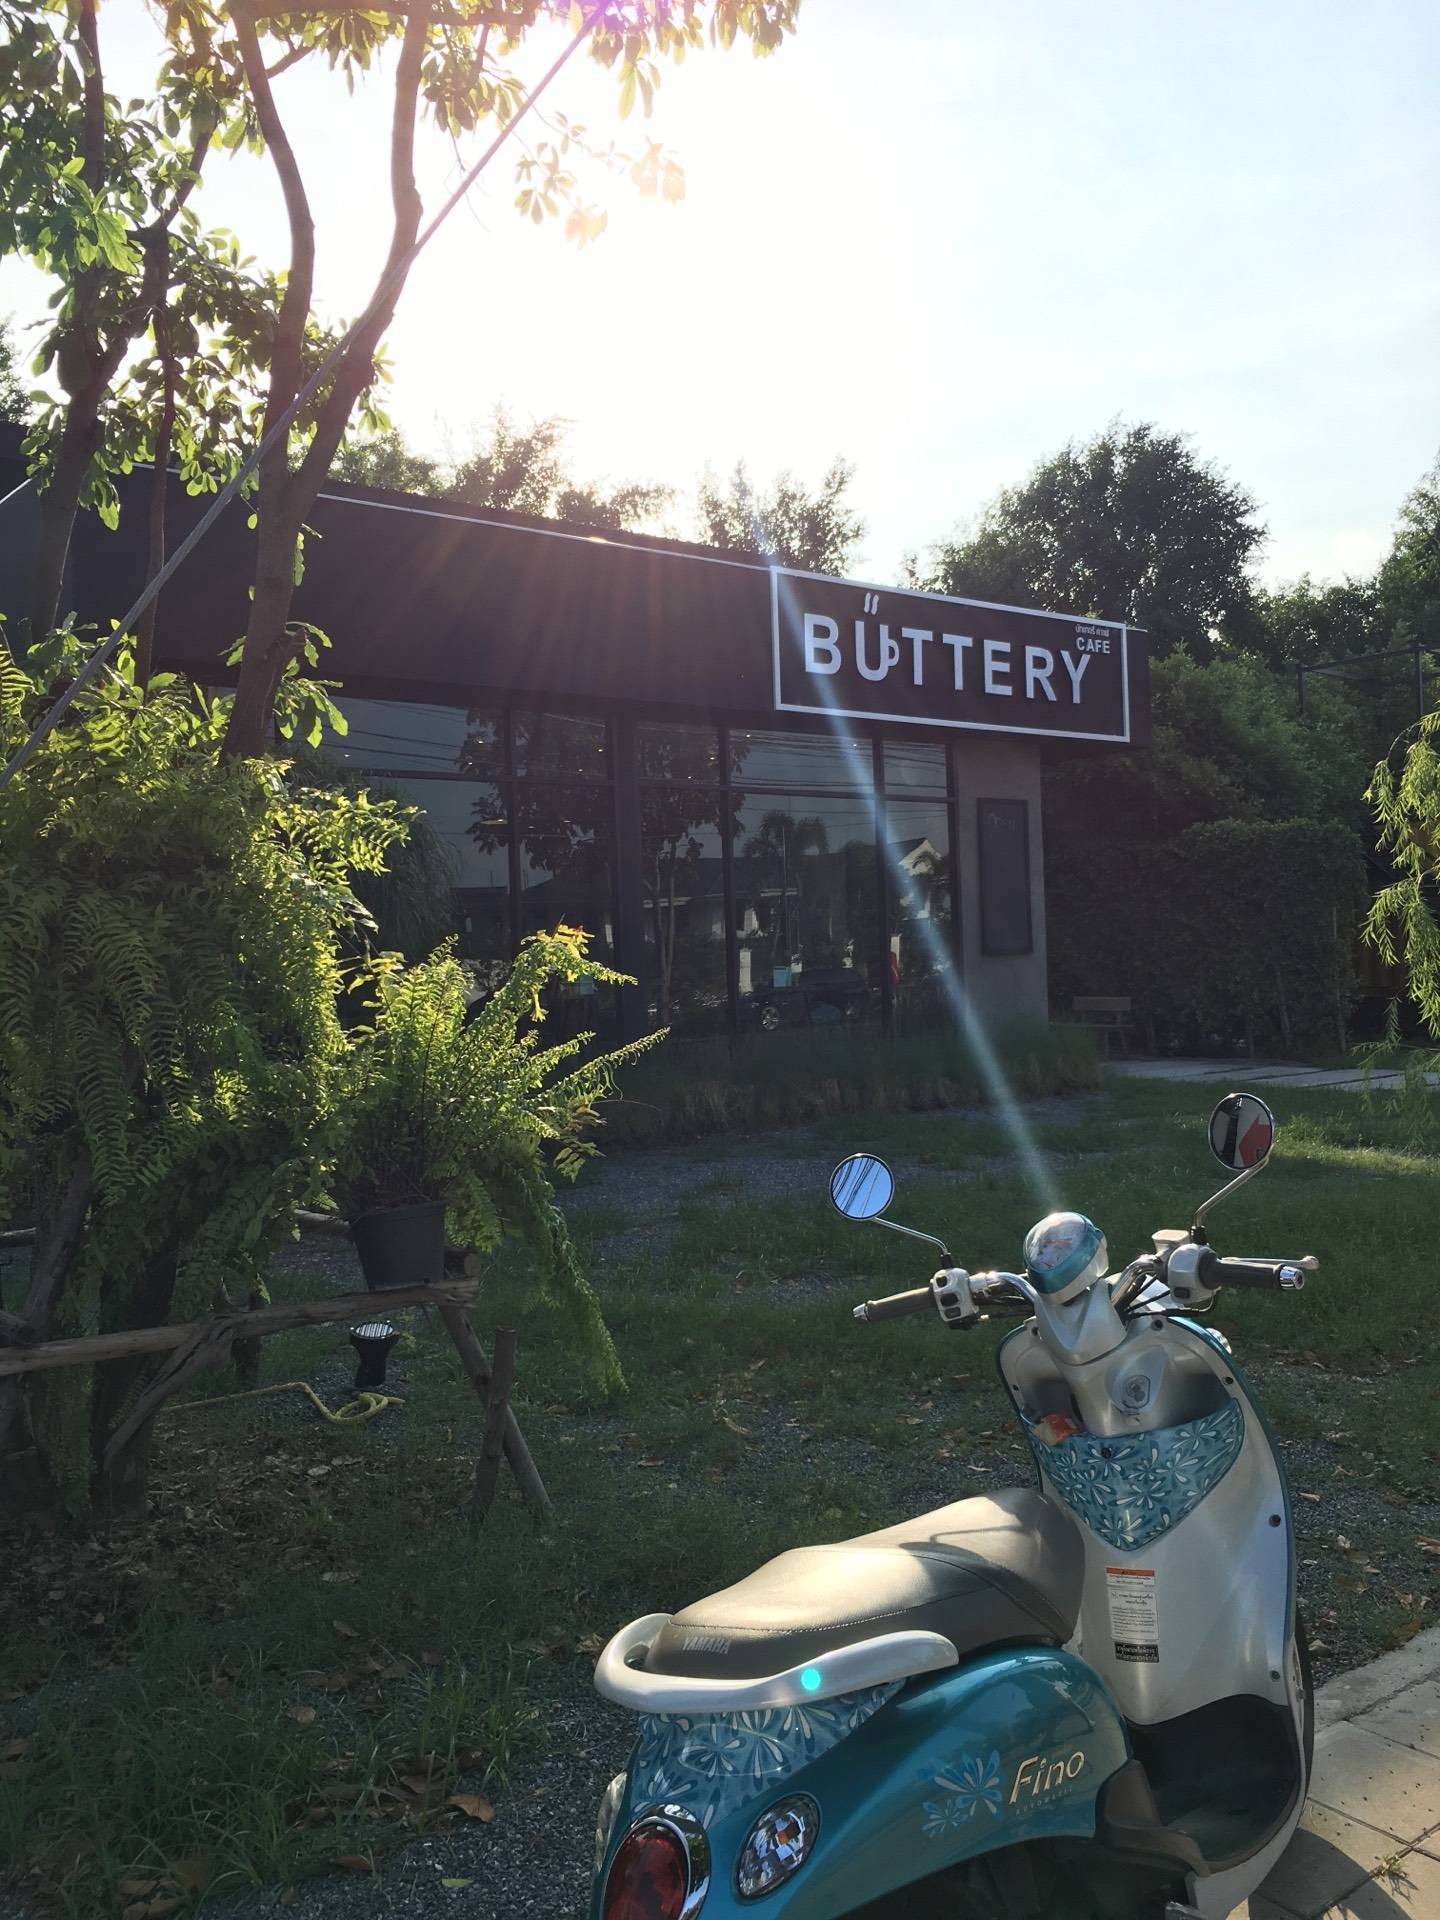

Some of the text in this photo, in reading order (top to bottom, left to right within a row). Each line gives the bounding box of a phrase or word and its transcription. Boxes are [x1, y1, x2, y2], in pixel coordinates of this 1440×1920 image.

[1076, 636, 1111, 654] CAFE
[682, 1636, 731, 1655] YAMAHA
[1009, 1751, 1085, 1805] Fino
